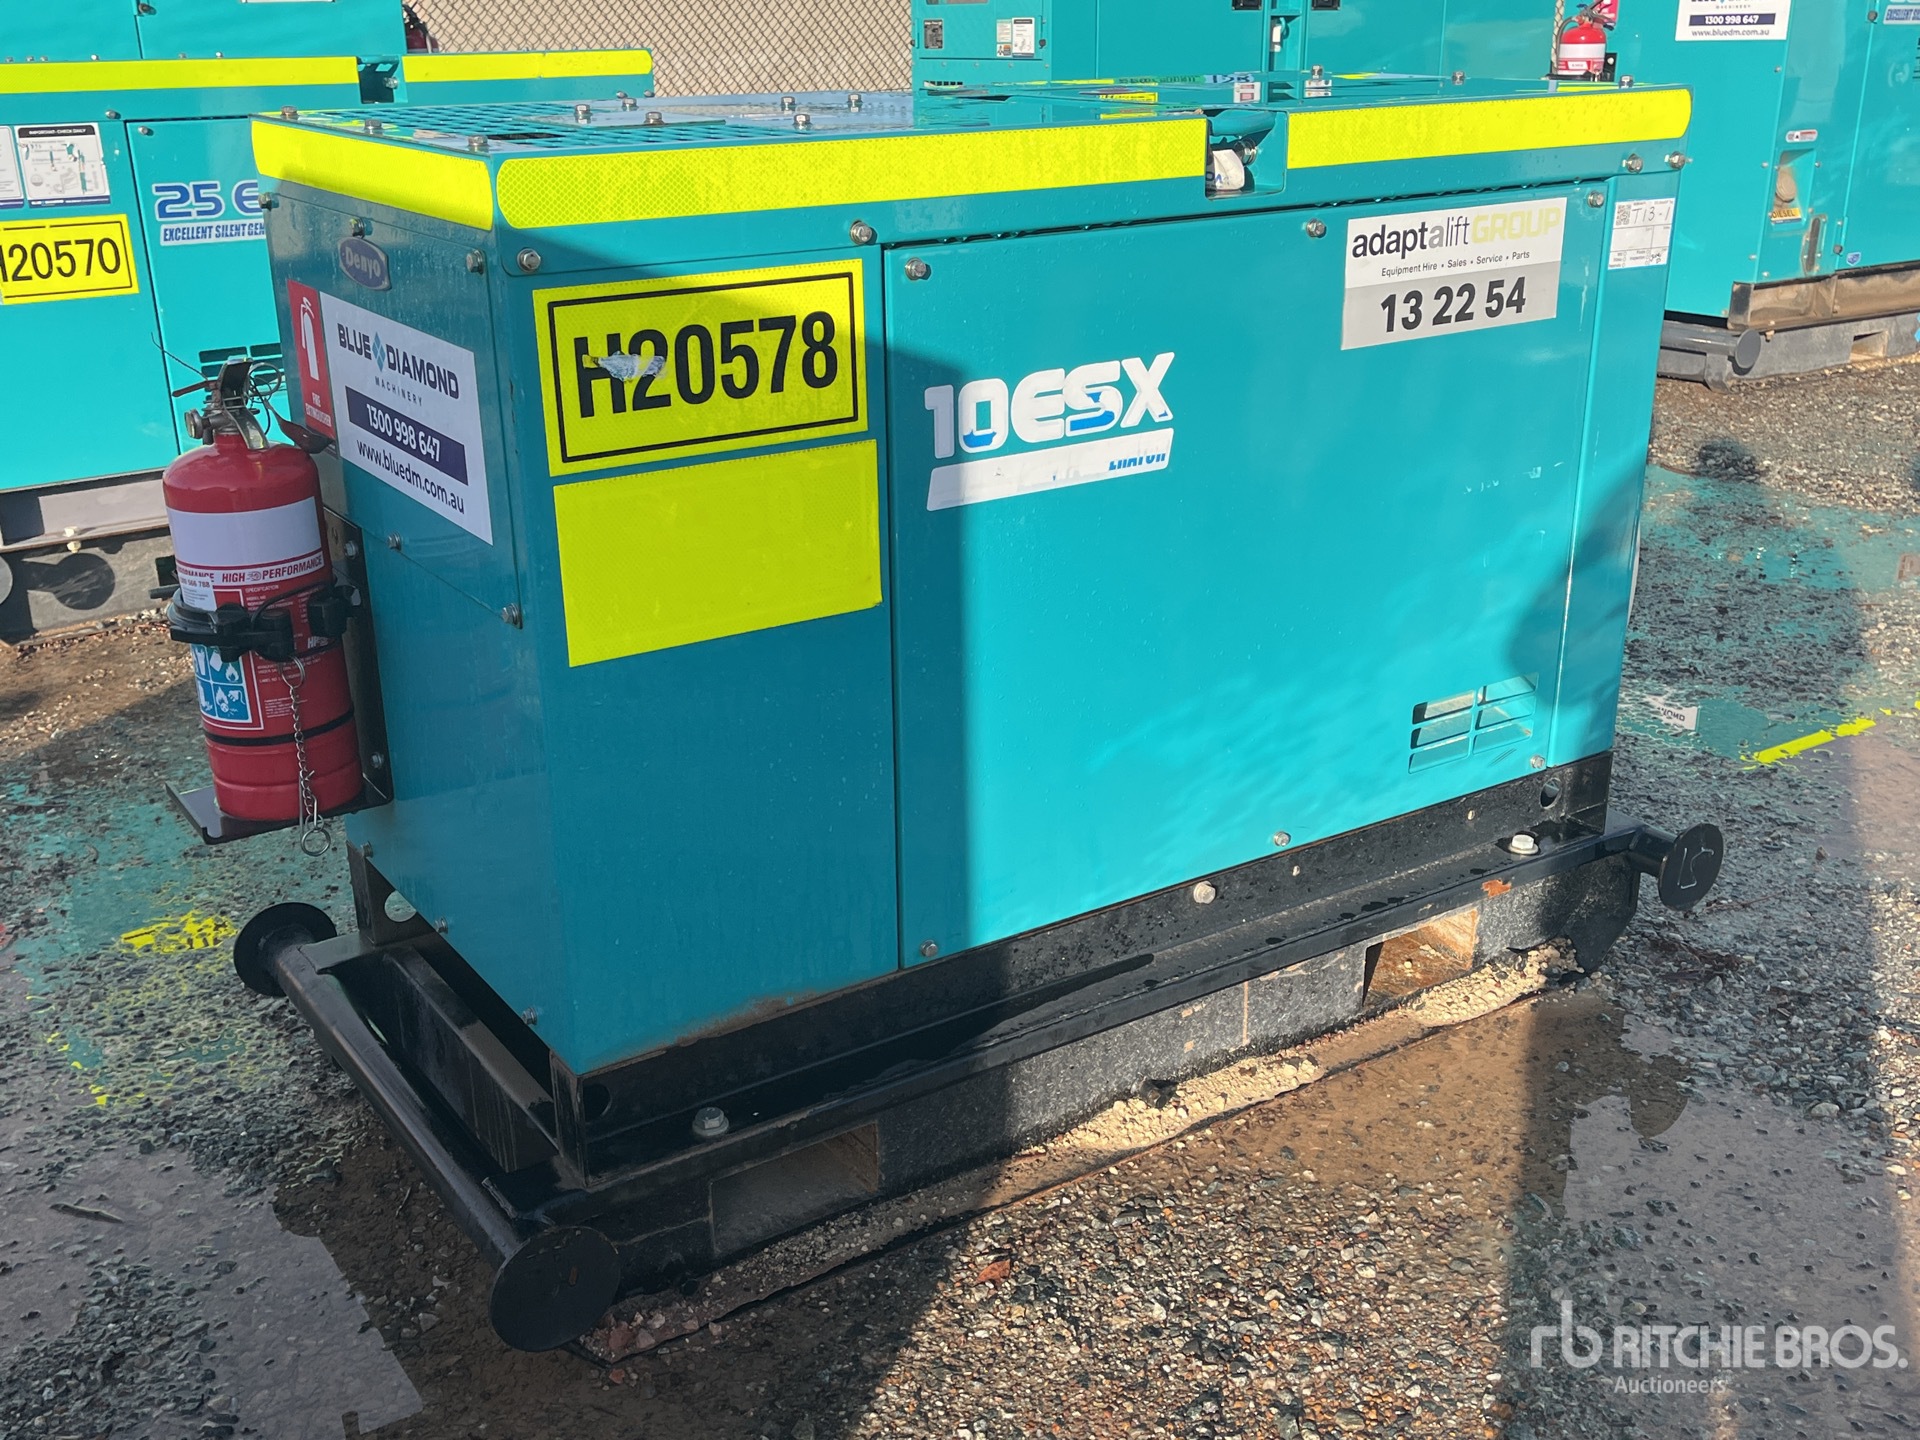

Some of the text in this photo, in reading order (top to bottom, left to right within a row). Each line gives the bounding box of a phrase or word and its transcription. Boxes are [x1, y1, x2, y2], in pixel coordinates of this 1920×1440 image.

[1691, 28, 1770, 37] www.bluedm.com.au
[1705, 14, 1760, 25] 1300 998 647
[154, 182, 224, 219] 25
[163, 225, 214, 242] EXCELLENT
[215, 223, 247, 239] SILENT
[343, 244, 382, 278] Denyo
[1381, 250, 1530, 277] Equipment Hire Sales Service Parts
[1380, 276, 1526, 333] 13 22 54
[337, 322, 460, 400] BLUE DIAMOND
[573, 310, 839, 418] H20578
[374, 375, 423, 407] MACHINERY
[923, 351, 1176, 459] 10ESX
[366, 403, 441, 463] 1300 998 647
[356, 439, 465, 515] www.bluedm.com.au
[221, 571, 246, 583] HIGH
[262, 555, 323, 581] PERFORMANCE
